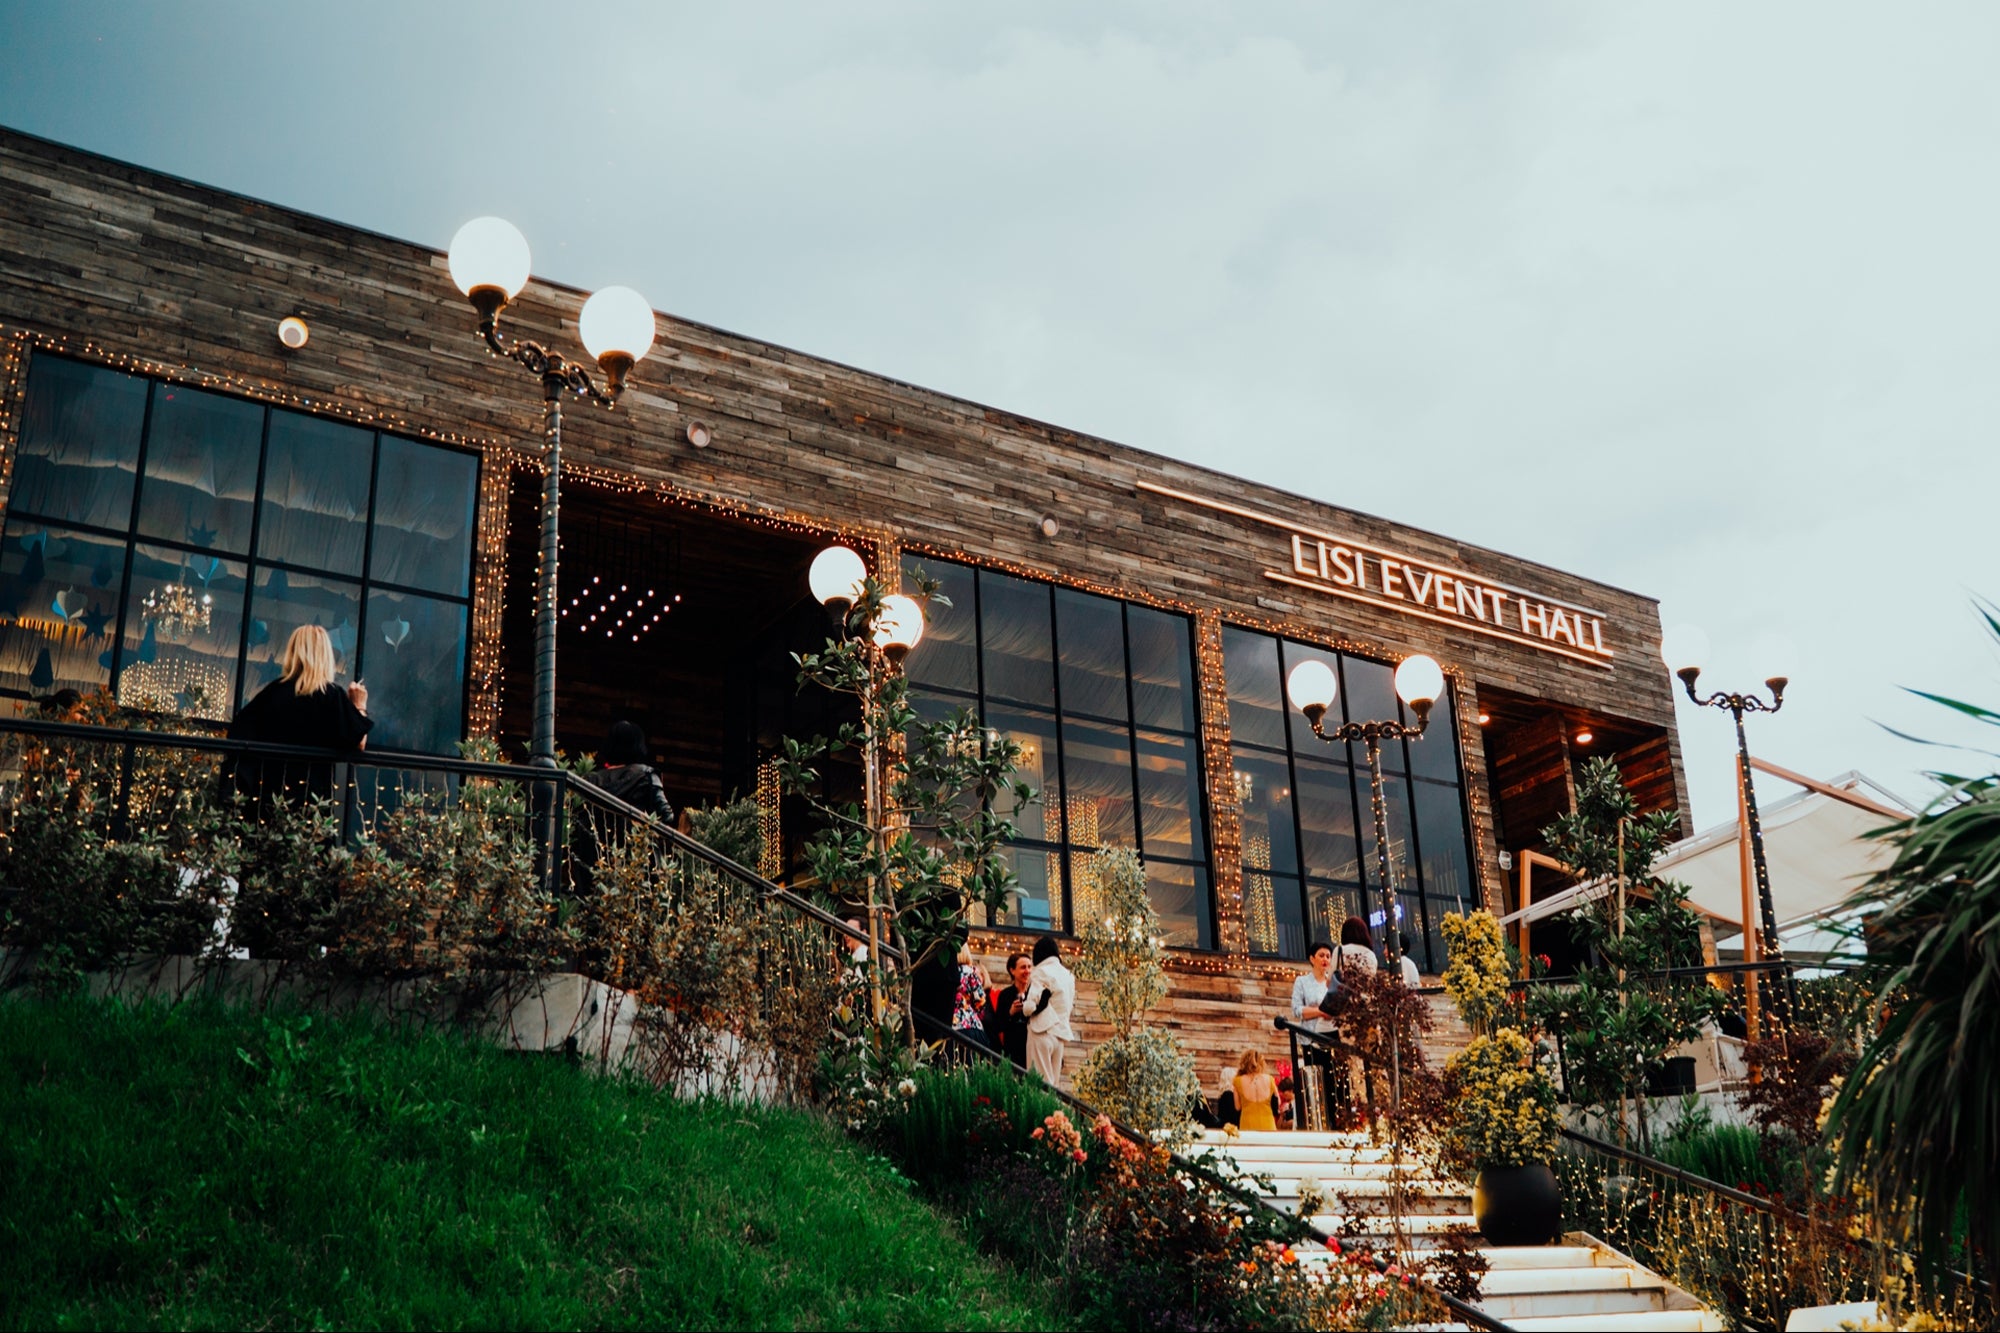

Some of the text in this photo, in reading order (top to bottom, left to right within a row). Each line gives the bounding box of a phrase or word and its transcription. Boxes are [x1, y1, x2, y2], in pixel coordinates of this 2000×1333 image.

[1292, 534, 1615, 657] LISI EVENT HALL
